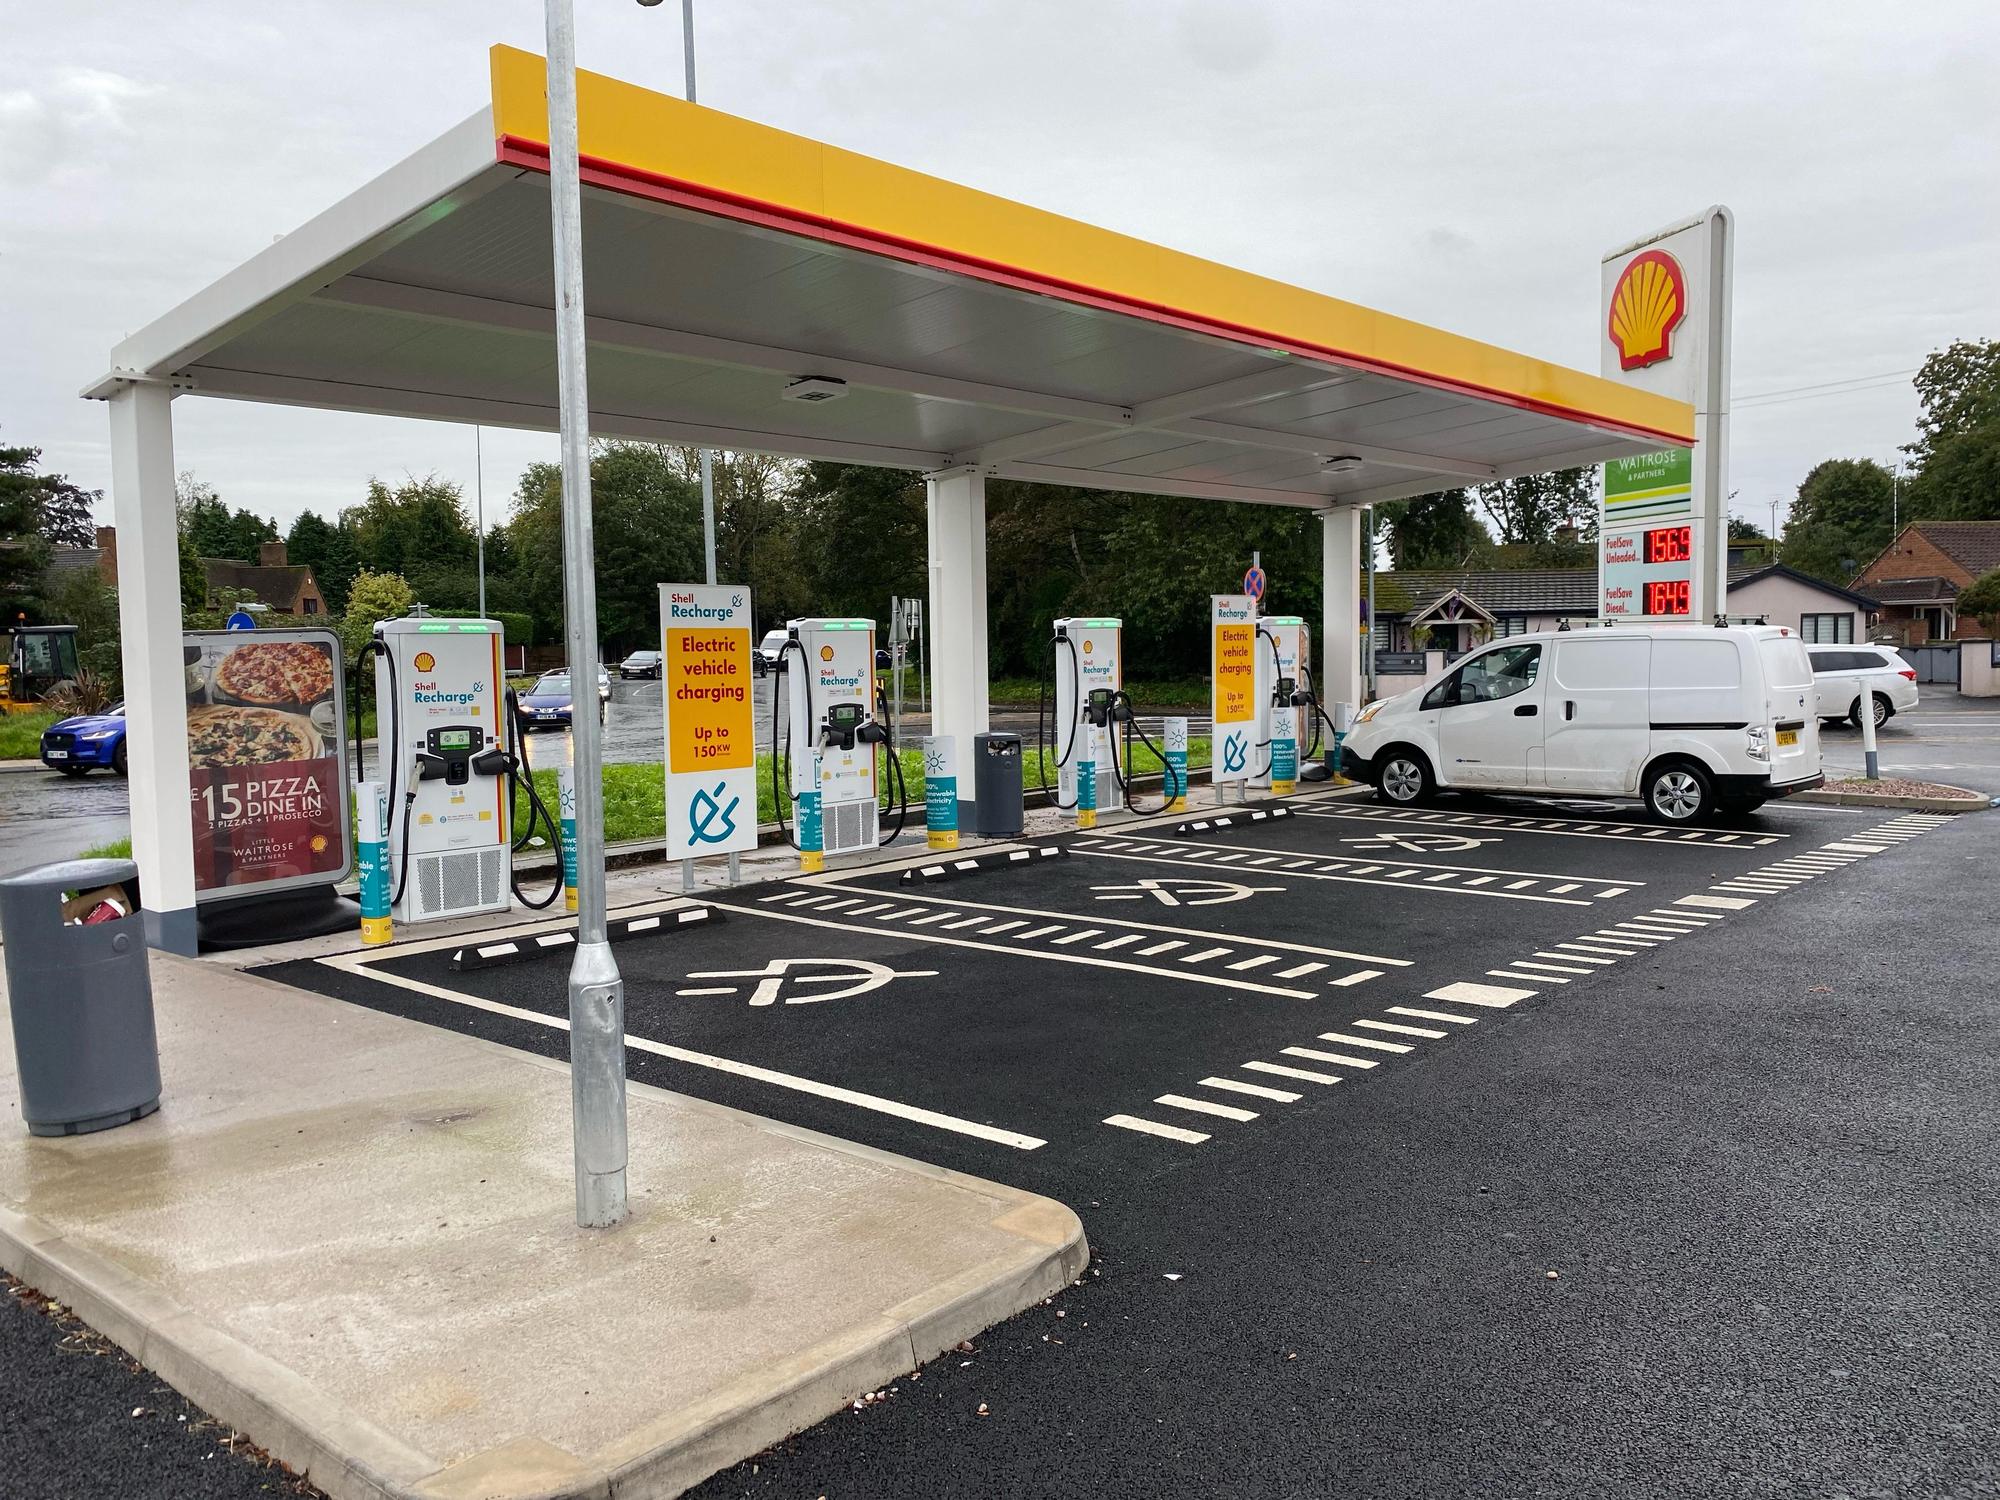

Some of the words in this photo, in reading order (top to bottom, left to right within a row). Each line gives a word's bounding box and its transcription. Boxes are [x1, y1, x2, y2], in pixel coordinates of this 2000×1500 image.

[1619, 449, 1677, 471] WAITROSE
[1633, 468, 1665, 481] PARTNERS
[1606, 536, 1633, 549] FuelSave
[1650, 527, 1691, 562] 156.9
[1606, 550, 1636, 564] Unleaded
[671, 593, 694, 603] Shell
[1606, 586, 1632, 599] FuelSave
[1649, 582, 1690, 614] 164.9
[671, 604, 733, 621] Recharge
[1218, 608, 1248, 619] Recharge
[1605, 602, 1624, 614] Diesel
[1222, 628, 1248, 641] Electric
[682, 635, 736, 652] Electric
[1223, 646, 1248, 657] vehicle
[683, 659, 736, 675] vehicle
[1083, 666, 1110, 674] Recharge
[1219, 662, 1252, 675] charging
[414, 682, 436, 691] Shell
[820, 676, 859, 686] Recharge
[414, 691, 474, 704] Recharge
[676, 683, 745, 703] charging
[1227, 692, 1236, 702] Up
[1238, 692, 1244, 700] to
[695, 727, 712, 742] Up
[717, 726, 729, 737] to
[246, 775, 321, 800] PIZZA
[247, 797, 296, 817] DINE
[302, 794, 321, 811] IN
[208, 821, 214, 829] 2
[218, 817, 253, 828] PIZZAS
[273, 809, 322, 822] PROSECCO
[251, 837, 275, 846] LITTLE
[233, 842, 294, 857] WAITROSE
[248, 852, 286, 863] PARTNERS
